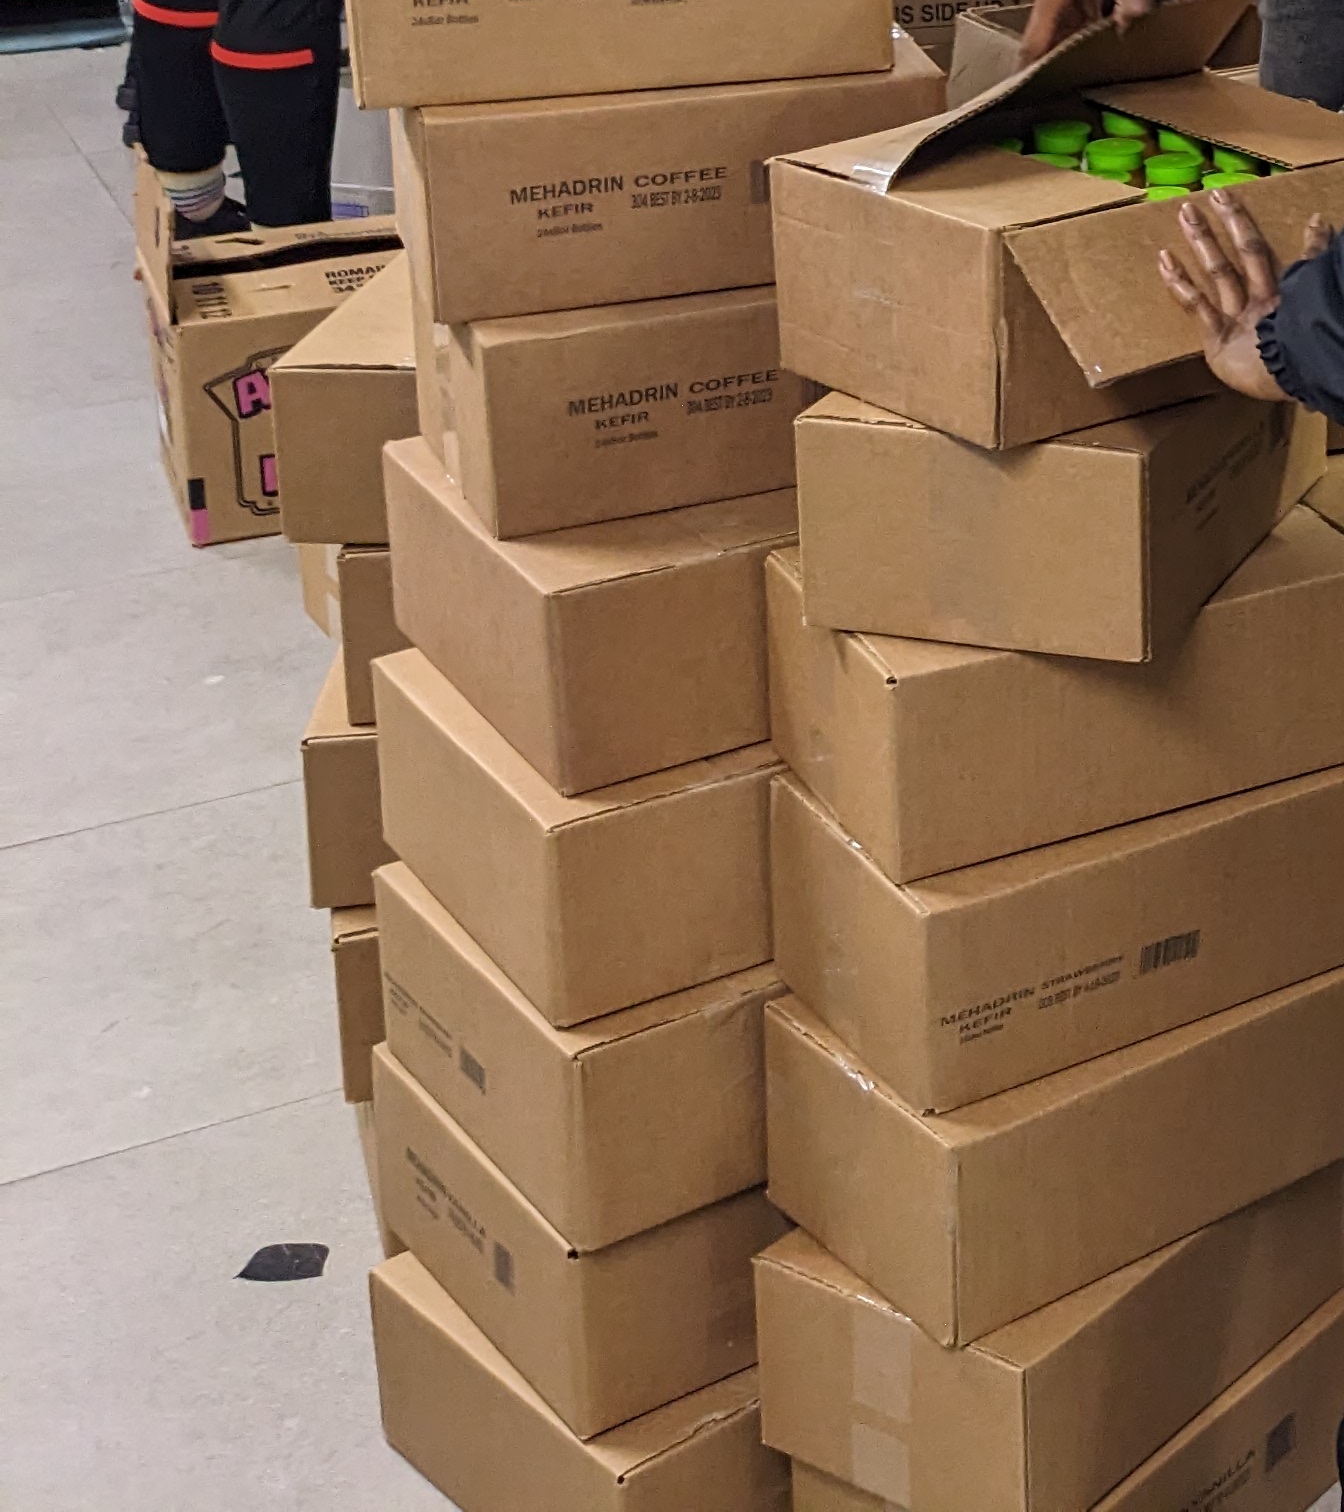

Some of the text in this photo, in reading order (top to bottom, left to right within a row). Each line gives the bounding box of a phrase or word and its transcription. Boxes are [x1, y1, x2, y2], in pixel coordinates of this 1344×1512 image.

[894, 5, 914, 25] IS
[510, 166, 728, 205] MEHADRIN COFFEE
[649, 191, 671, 208] BEST
[671, 189, 683, 206] BY
[537, 202, 594, 220] KEFIR
[568, 369, 779, 417] MEHADRIN COFFEE
[594, 411, 650, 431] KEFIR
[940, 987, 1036, 1027] MEHADRIN
[959, 1006, 1013, 1034] KEFIR
